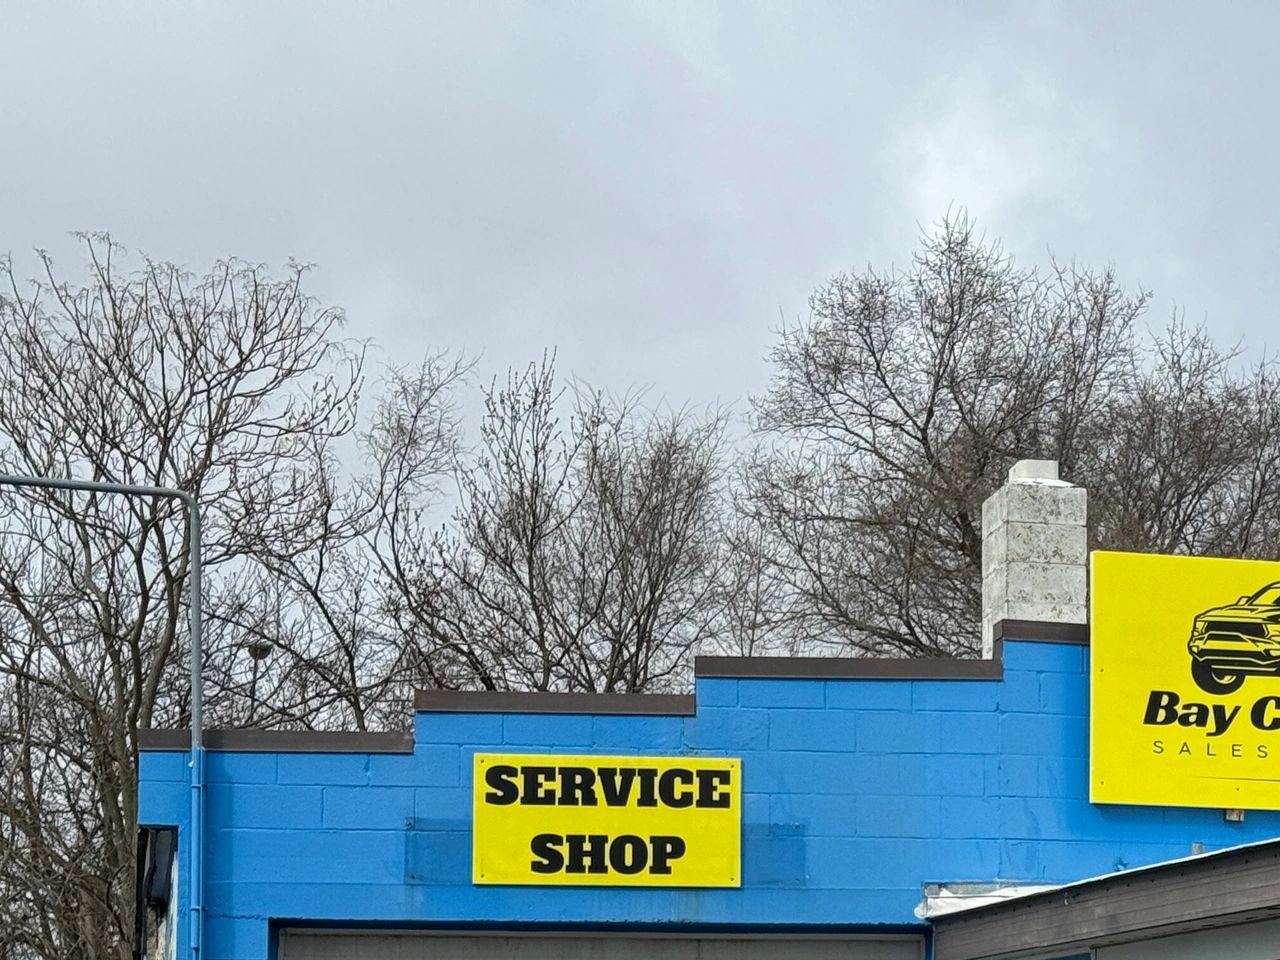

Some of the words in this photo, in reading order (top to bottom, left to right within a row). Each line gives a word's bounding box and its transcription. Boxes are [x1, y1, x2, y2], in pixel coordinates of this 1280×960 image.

[1143, 690, 1241, 737] Bay
[1153, 741, 1270, 759] SALES
[485, 765, 731, 808] SERVICE
[530, 834, 686, 875] SHOP
